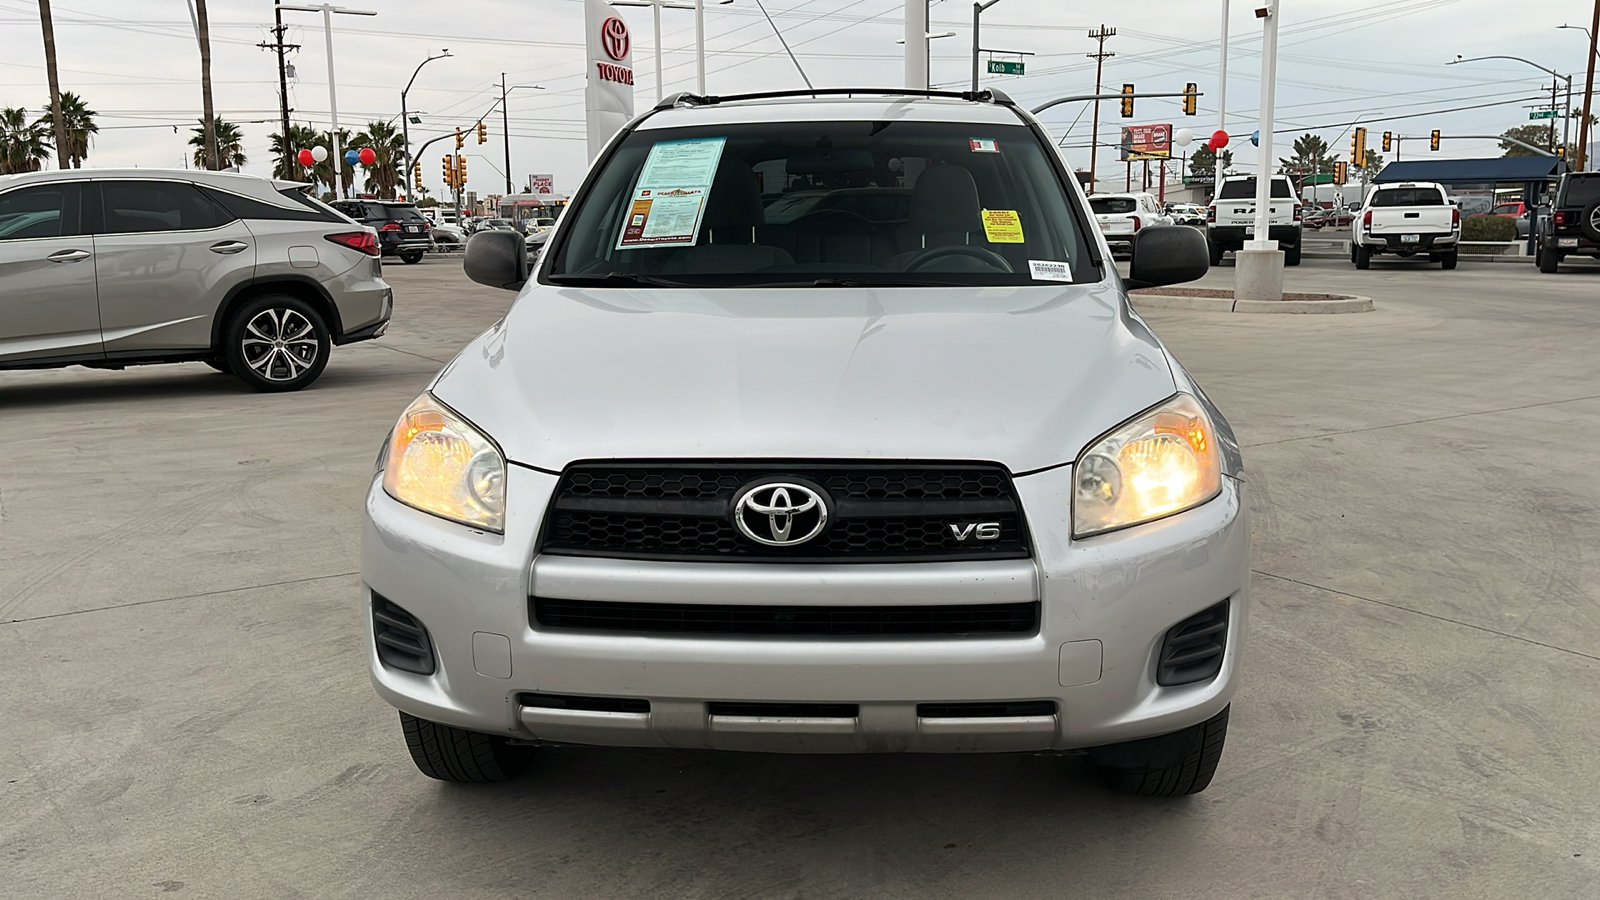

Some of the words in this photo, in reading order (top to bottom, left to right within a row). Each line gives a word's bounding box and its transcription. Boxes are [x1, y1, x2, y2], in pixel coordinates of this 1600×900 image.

[597, 62, 635, 86] TOYOTA
[991, 62, 1006, 73] Kolb
[1184, 176, 1215, 184] enterprise
[949, 522, 1000, 541] V6
